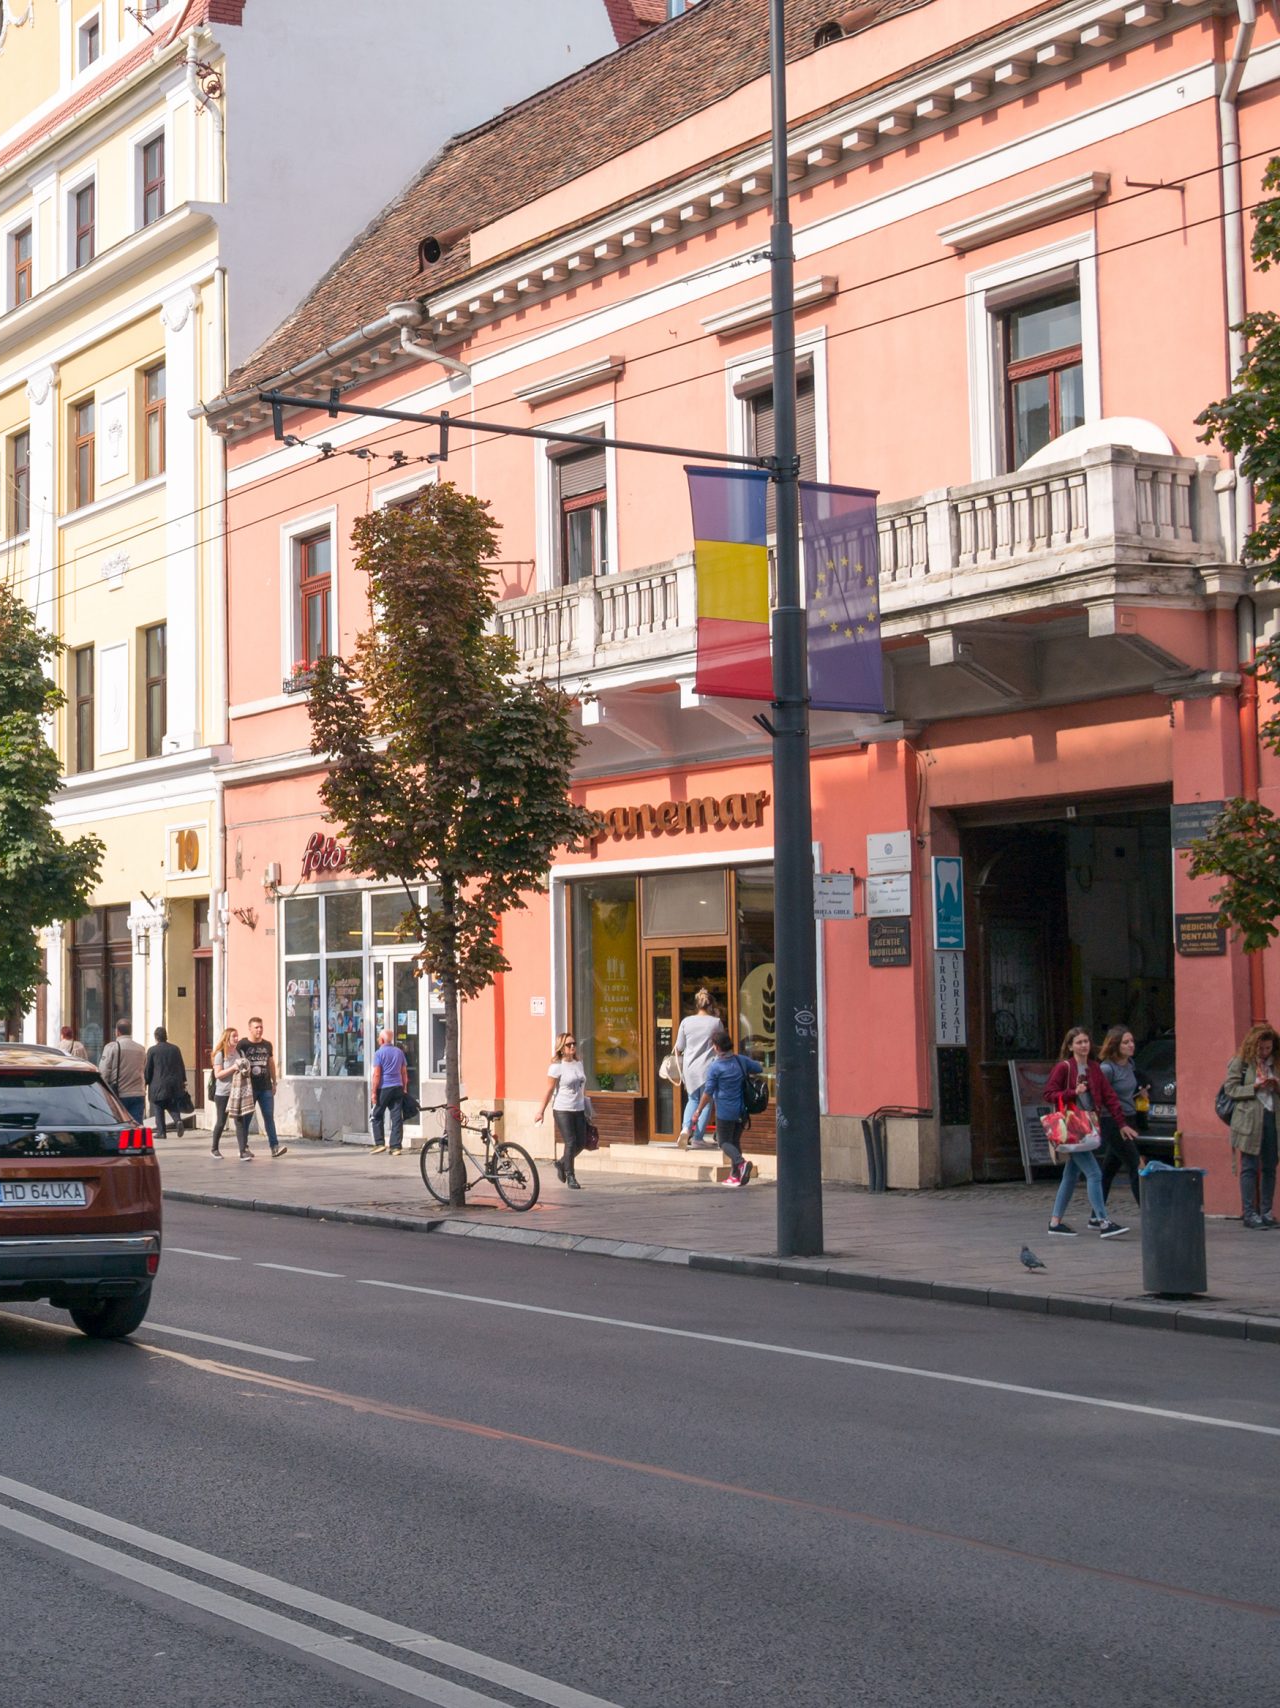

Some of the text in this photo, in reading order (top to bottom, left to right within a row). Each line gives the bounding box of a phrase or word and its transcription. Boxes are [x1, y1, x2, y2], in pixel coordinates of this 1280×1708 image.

[175, 830, 200, 872] 10
[939, 957, 948, 1039] TRADUCERI
[952, 953, 961, 1044] AUTORIZATE
[3, 1184, 26, 1200] HD
